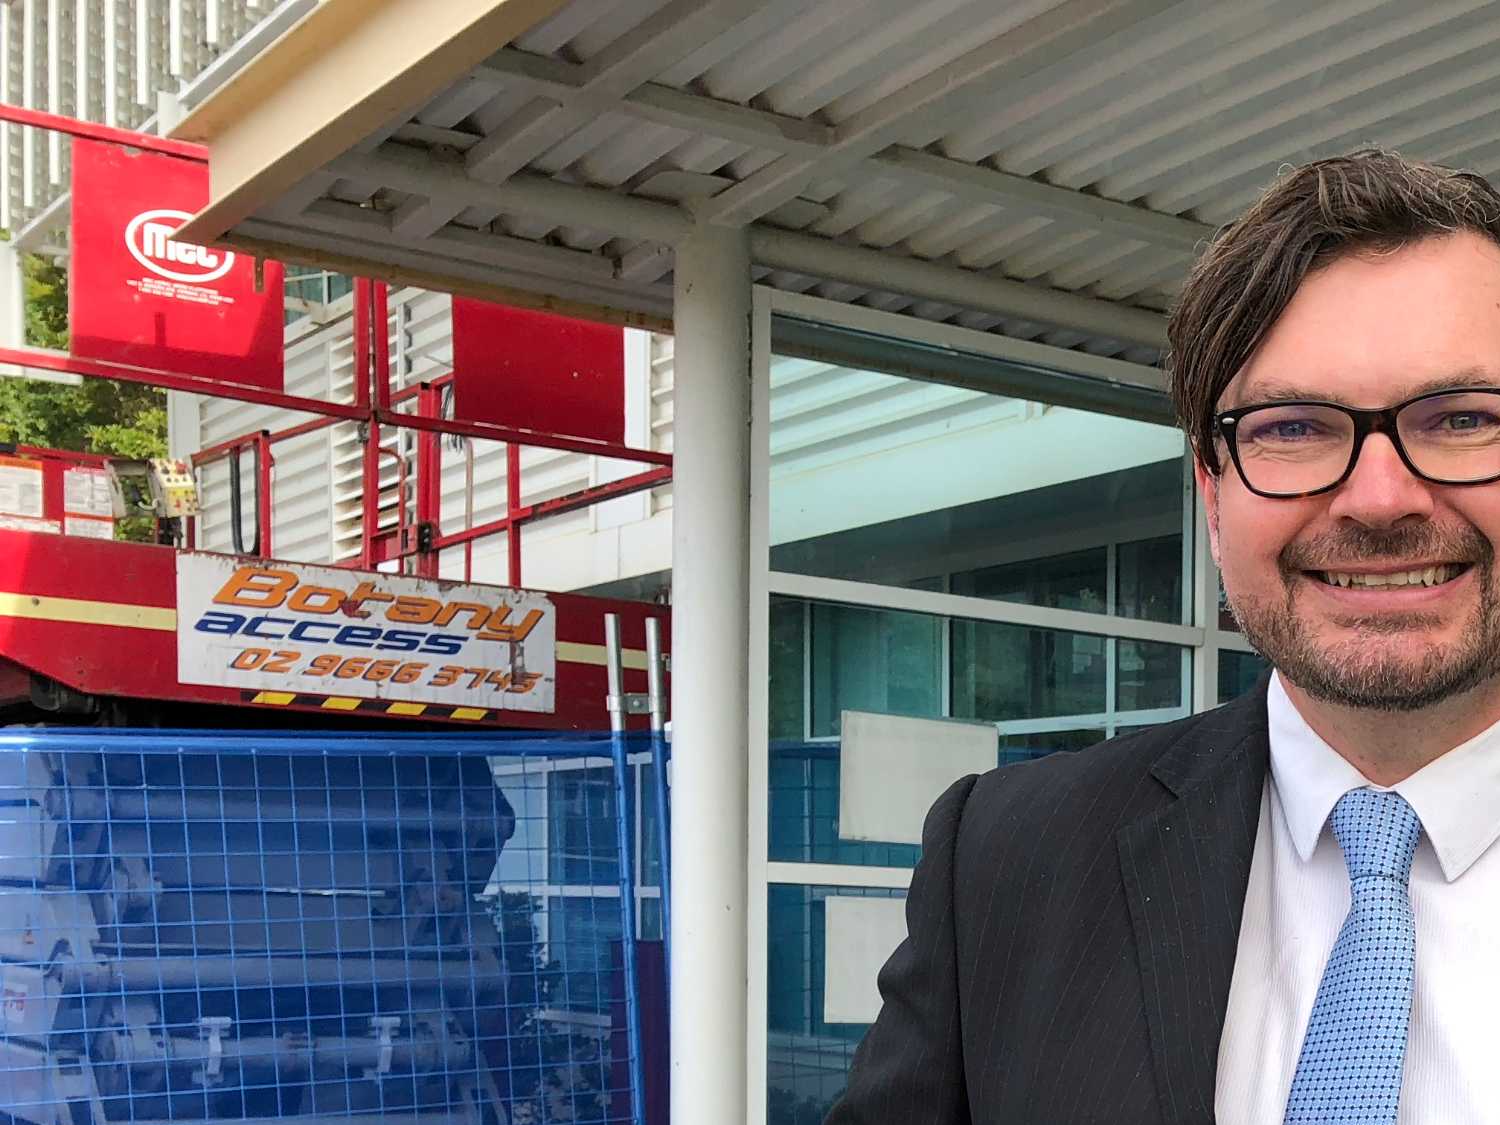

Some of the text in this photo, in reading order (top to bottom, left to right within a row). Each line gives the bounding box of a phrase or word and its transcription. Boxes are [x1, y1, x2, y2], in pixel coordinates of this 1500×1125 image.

[212, 566, 544, 642] Botany
[194, 611, 469, 655] access
[230, 648, 544, 694] 02 9666 3745
